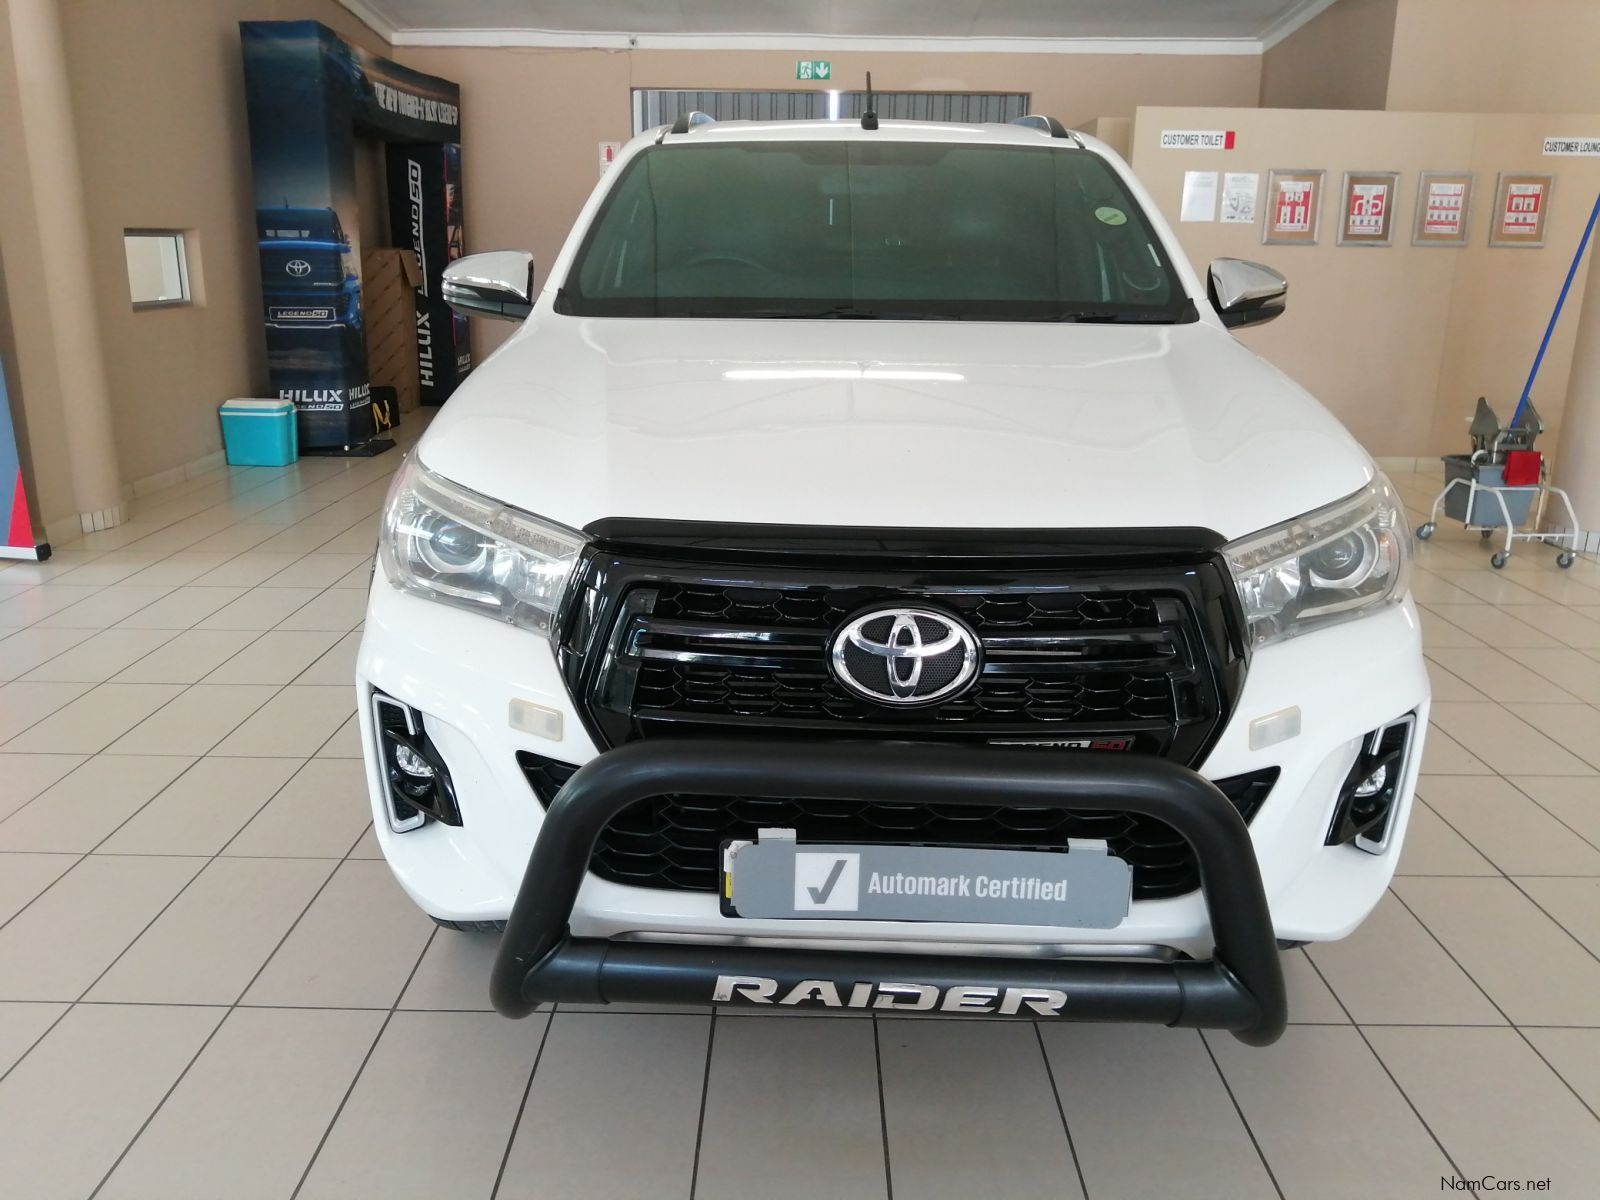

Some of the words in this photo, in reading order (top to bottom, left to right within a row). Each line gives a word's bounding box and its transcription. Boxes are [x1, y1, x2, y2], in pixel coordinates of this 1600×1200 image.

[1162, 134, 1199, 146] CUSTOMER
[1201, 134, 1224, 146] TOILET
[1544, 141, 1579, 152] CUSTOMER
[416, 310, 435, 387] HILUX
[280, 389, 343, 402] HILUX
[348, 383, 371, 401] HILUX
[868, 872, 971, 898] Automark
[975, 874, 1068, 902] Certified
[712, 974, 1068, 1016] RAIDER
